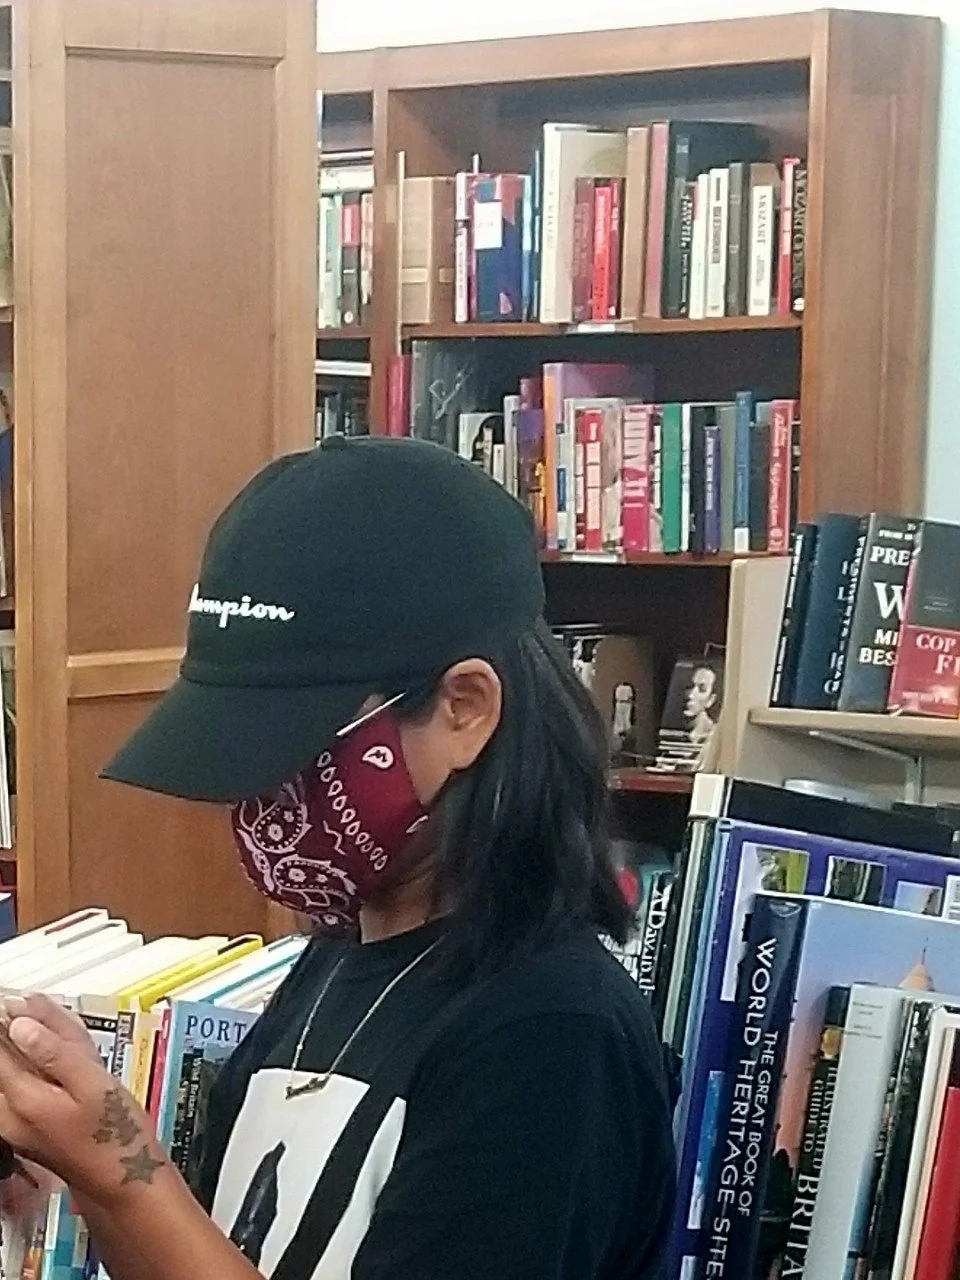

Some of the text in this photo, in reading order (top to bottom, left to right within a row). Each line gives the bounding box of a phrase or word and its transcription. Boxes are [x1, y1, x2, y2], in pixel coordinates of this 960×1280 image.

[185, 1015, 247, 1044] PORT
[743, 937, 778, 1047] WORLD
[720, 1057, 755, 1206] HERITAGE
[737, 1030, 779, 1217] THE GREAT BOOK OF
[803, 1128, 816, 1153] TO
